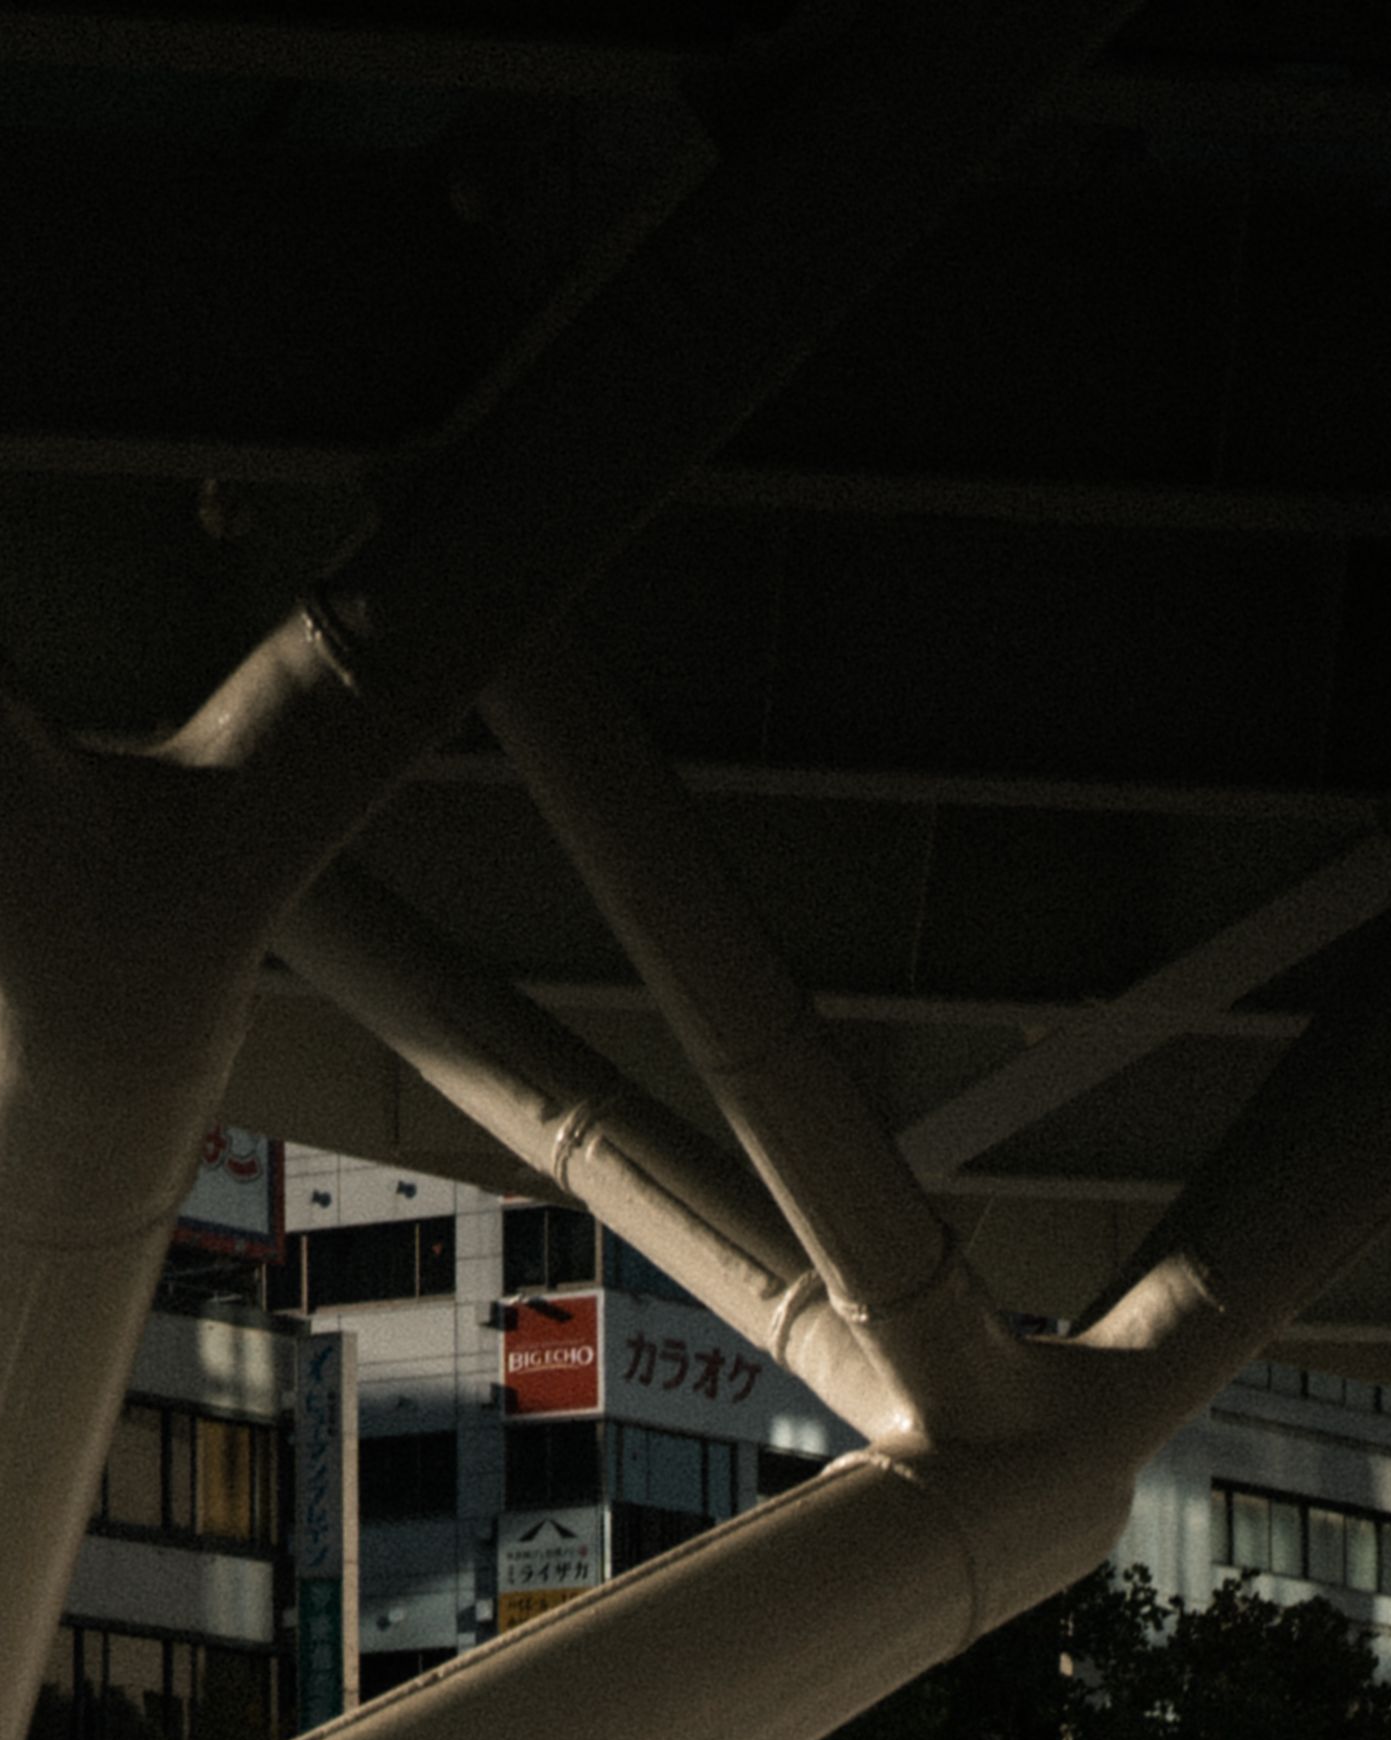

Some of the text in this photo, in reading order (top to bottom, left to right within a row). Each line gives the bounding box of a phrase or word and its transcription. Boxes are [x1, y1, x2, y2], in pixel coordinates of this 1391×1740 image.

[508, 1345, 595, 1373] BIG ECHO
[624, 1331, 762, 1403] カラオケ
